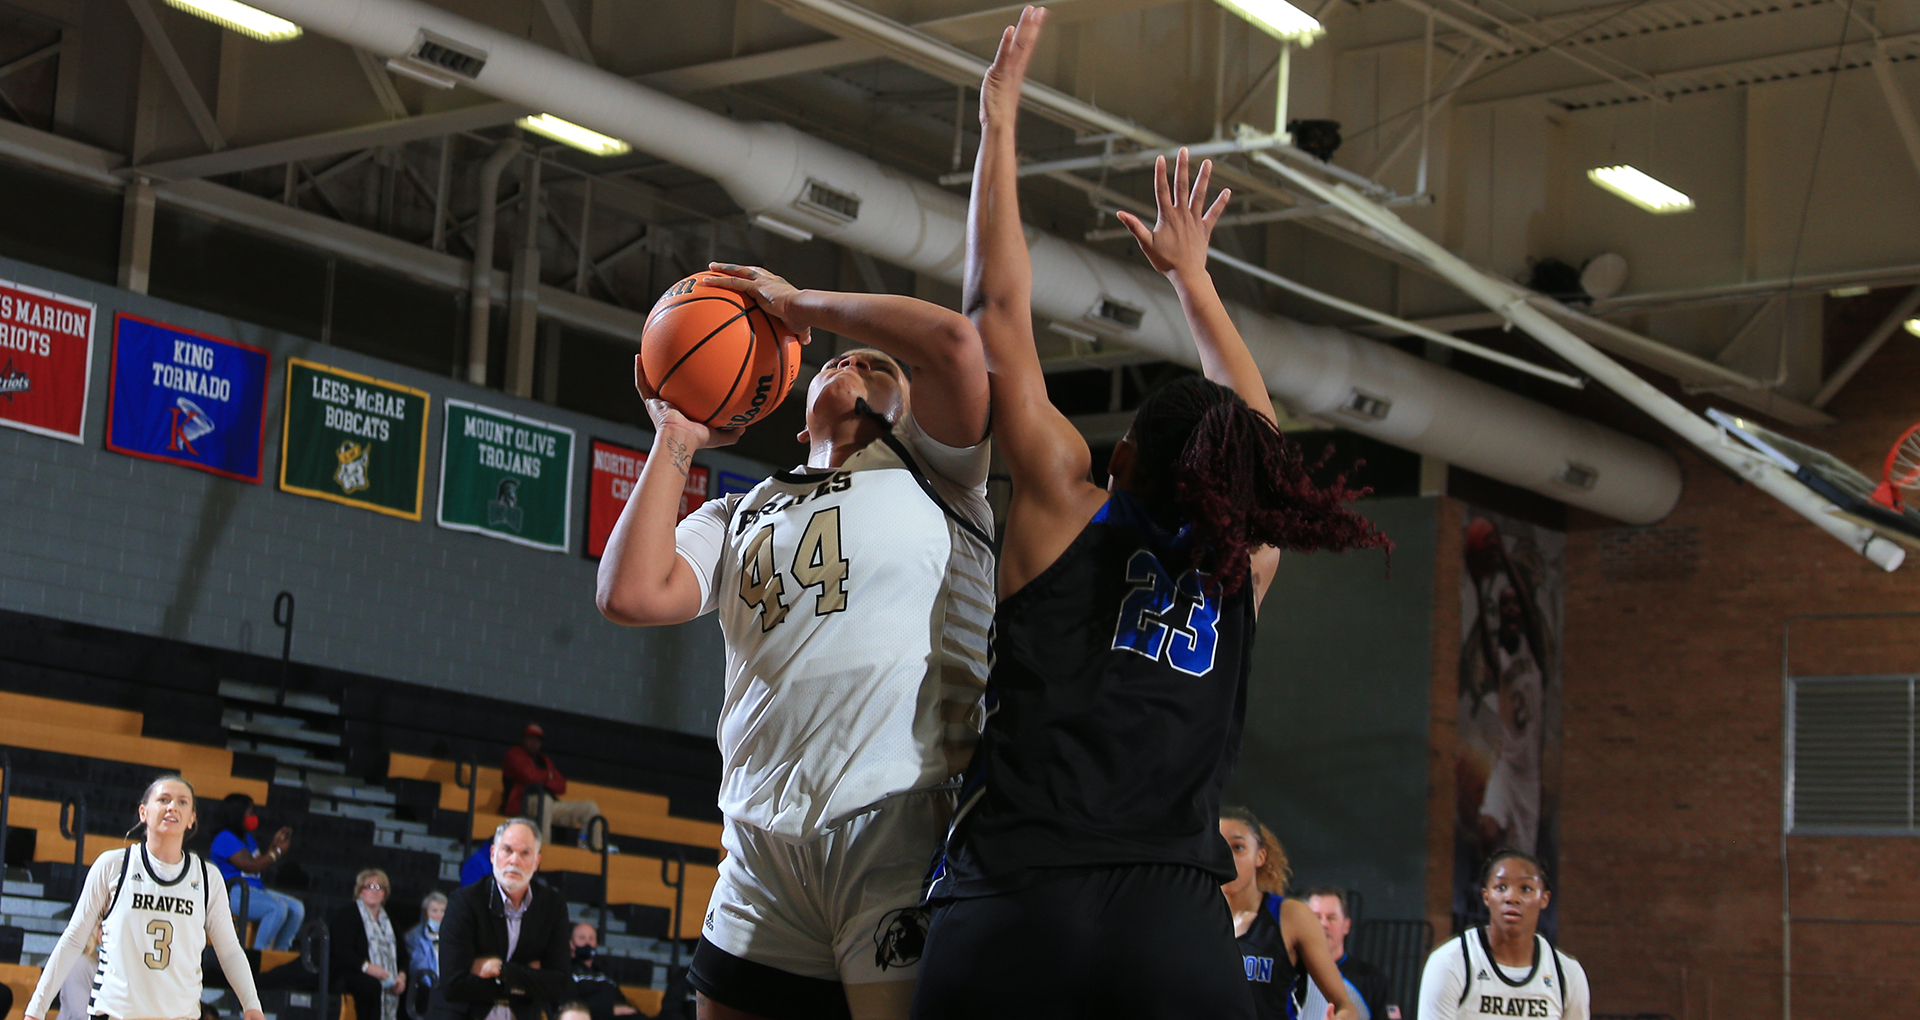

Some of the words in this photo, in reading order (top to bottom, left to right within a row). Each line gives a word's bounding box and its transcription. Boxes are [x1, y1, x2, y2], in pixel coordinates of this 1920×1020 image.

[15, 298, 87, 338] MARION
[173, 340, 214, 371] KING
[153, 363, 231, 402] TORNADO
[717, 373, 775, 431] ilson
[325, 405, 390, 441] BOBCATS
[464, 415, 514, 443] MOUNT
[515, 426, 556, 458] OLIVE
[478, 443, 542, 479] TROJANS
[594, 449, 635, 478] NORTH
[739, 505, 849, 633] 44
[1111, 549, 1224, 677] 23
[131, 893, 194, 916] BRAVES
[144, 919, 174, 971] 3
[1243, 955, 1275, 983] ON
[1479, 995, 1549, 1018] BRAVES
